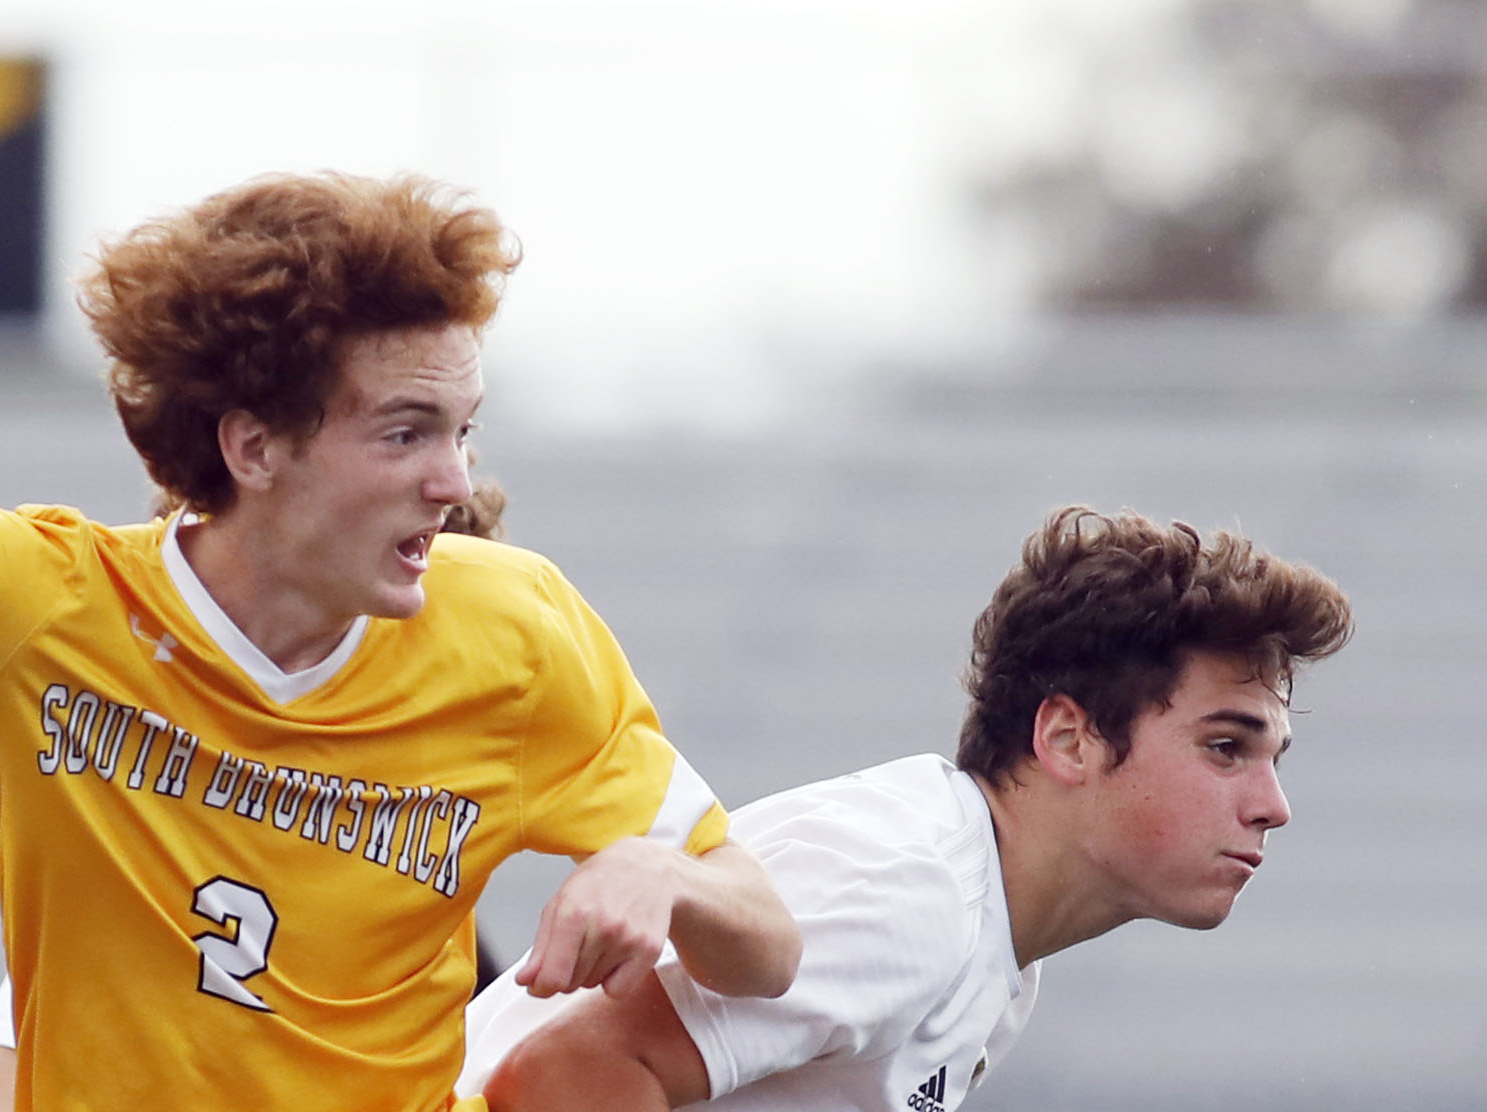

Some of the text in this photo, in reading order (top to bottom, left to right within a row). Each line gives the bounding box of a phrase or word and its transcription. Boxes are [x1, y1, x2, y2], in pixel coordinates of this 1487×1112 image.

[37, 683, 481, 898] SOUTH BRUNSWICK
[190, 875, 279, 1014] 2
